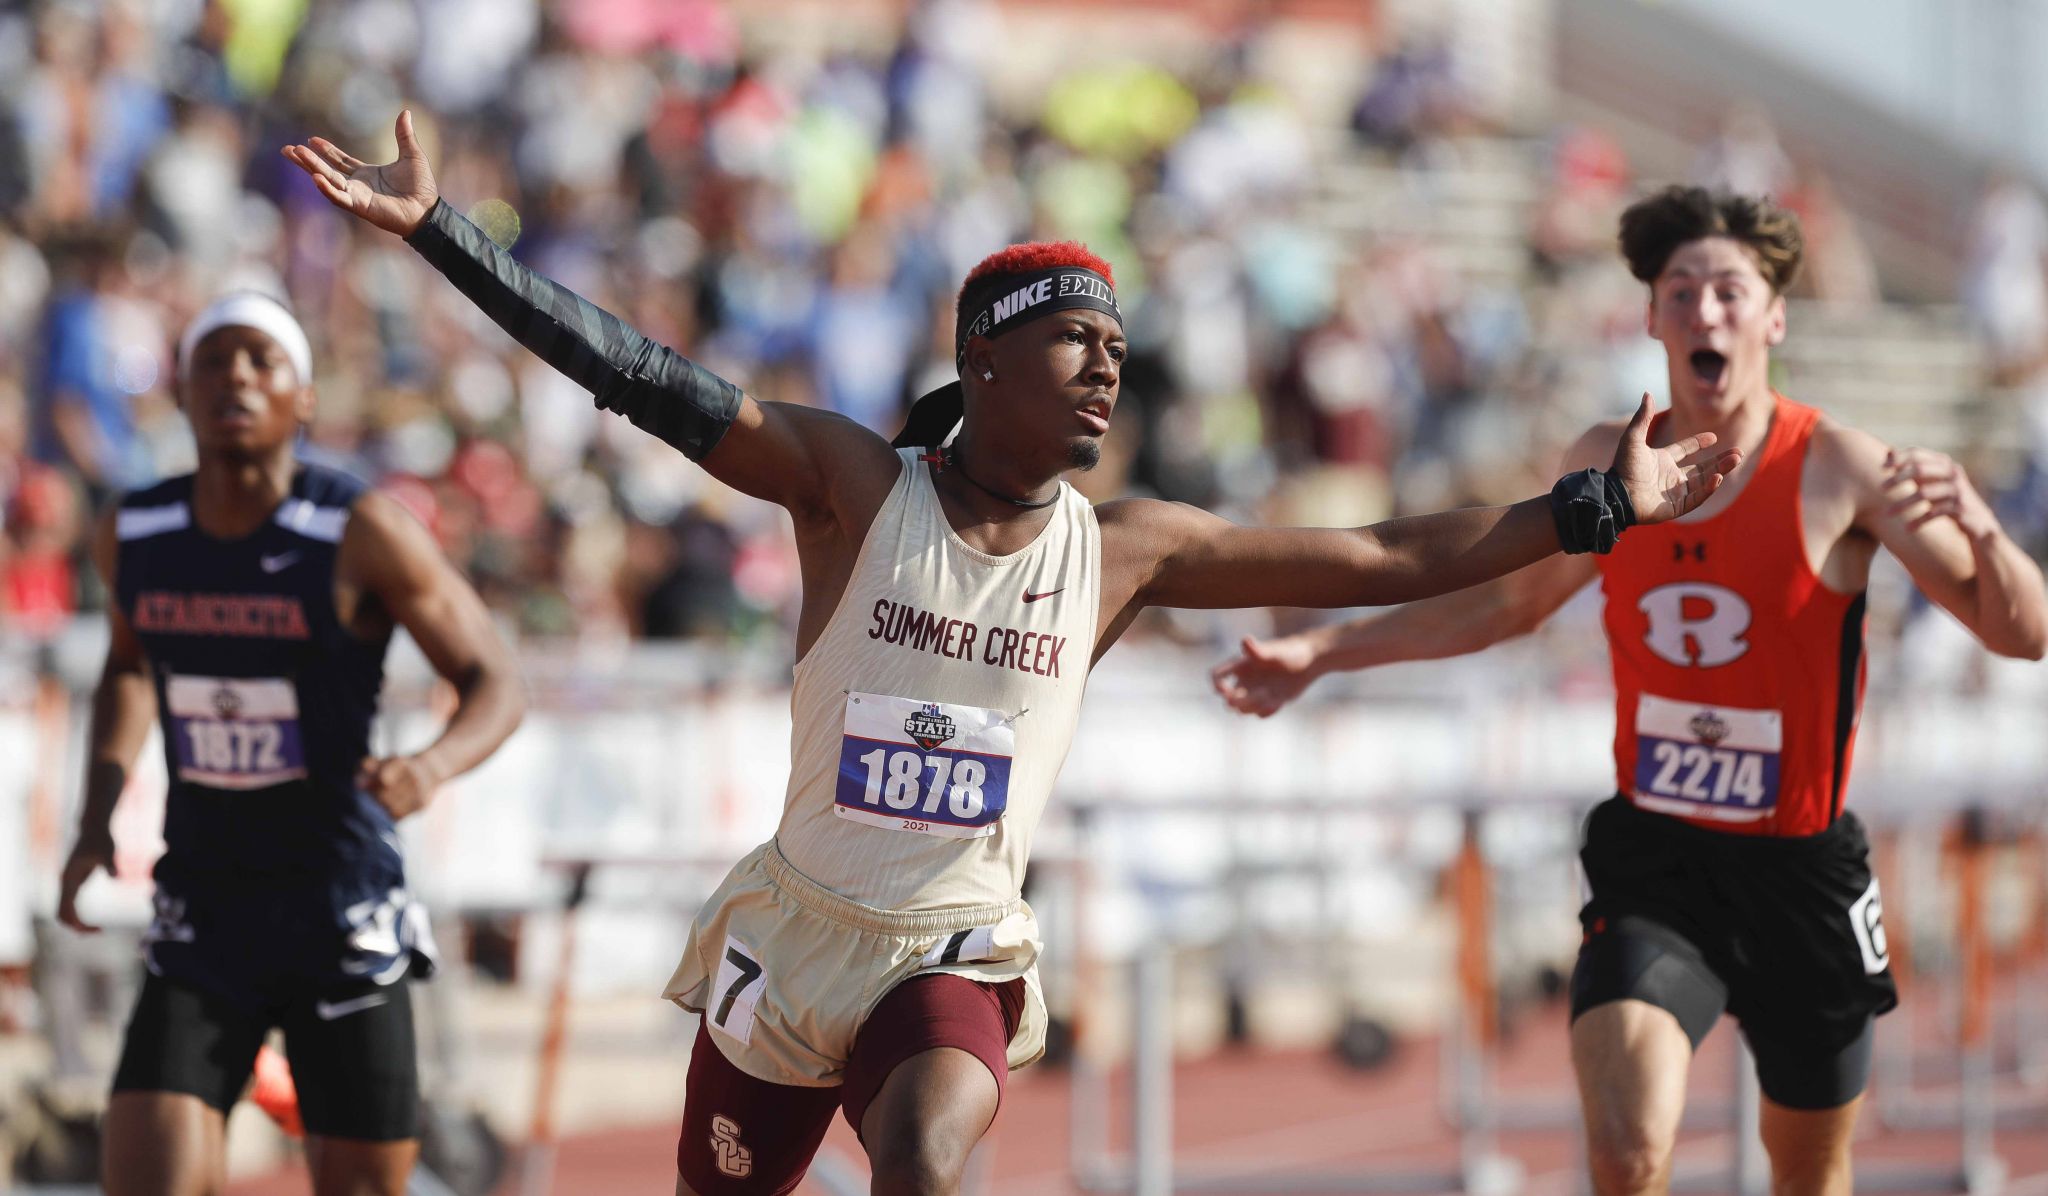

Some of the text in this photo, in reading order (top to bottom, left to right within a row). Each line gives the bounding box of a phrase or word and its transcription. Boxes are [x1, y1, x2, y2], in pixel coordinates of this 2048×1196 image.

[993, 277, 1053, 325] NIKE
[867, 598, 1067, 678] SUMMER CREEK
[1637, 581, 1752, 668] R
[184, 721, 288, 772] 1872
[905, 719, 955, 737] STATE
[859, 748, 986, 819] 1878
[1650, 742, 1765, 806] 2274
[902, 820, 929, 831] 2021
[714, 945, 762, 1028] 7
